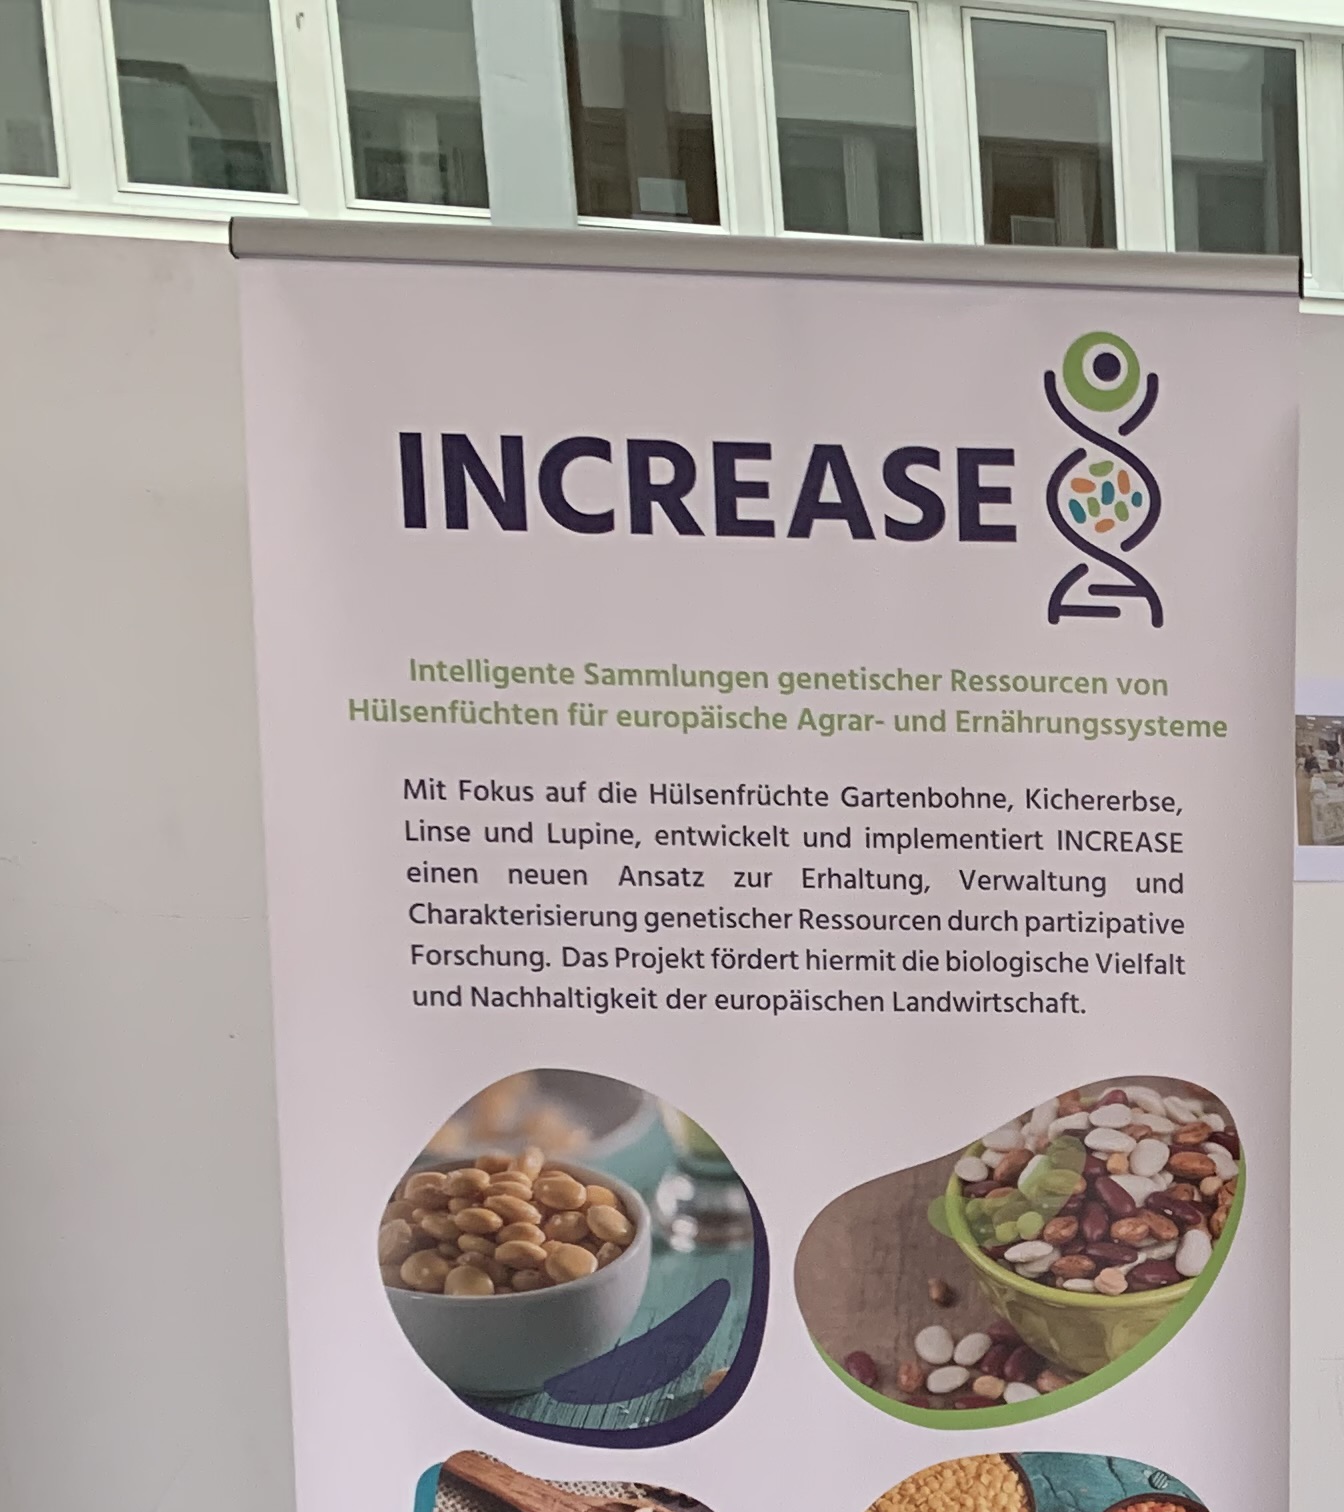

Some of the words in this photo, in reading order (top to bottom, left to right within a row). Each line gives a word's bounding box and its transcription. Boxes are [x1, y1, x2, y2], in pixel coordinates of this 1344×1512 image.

[398, 431, 1017, 542] INCREASE
[410, 658, 575, 689] Intelligente
[583, 662, 768, 694] Sammlungen
[777, 666, 942, 695] genetischer
[950, 668, 1107, 694] Ressourcen
[1116, 677, 1168, 696] von
[348, 698, 558, 726] Hülsenfüchten
[567, 702, 608, 727] für
[616, 704, 787, 734] europäische
[797, 707, 884, 737] Agrar-
[894, 709, 946, 732] und
[955, 709, 1227, 742] Ernährungssysteme
[403, 777, 447, 800] Mit
[458, 779, 534, 802] Fokus
[545, 780, 586, 802] auf
[598, 781, 637, 804] die
[649, 782, 828, 807] Hülsenfrüchte
[840, 786, 1013, 812] Gartenbohne,
[1026, 787, 1182, 816] Kichererbse,
[405, 818, 471, 842] Linse
[484, 821, 533, 843] und
[547, 822, 641, 850] Lupine,
[655, 824, 790, 847] entwickelt
[803, 826, 851, 848] und
[865, 826, 1044, 854] implementiert
[1057, 829, 1183, 853] INCREASE
[407, 860, 478, 883] einen
[508, 868, 587, 885] neuen
[618, 865, 705, 887] Ansatz
[734, 871, 773, 888] zur
[802, 867, 930, 895] Erhaltung,
[959, 869, 1106, 898] Verwaltung
[1136, 872, 1184, 894] und
[409, 901, 637, 933] Charakterisierung
[644, 906, 793, 933] genetischer
[799, 908, 941, 931] Ressourcen
[947, 909, 1018, 931] durch
[1025, 910, 1185, 938] partizipative
[410, 944, 550, 972] Forschung.
[562, 946, 608, 968] Das
[615, 946, 705, 974] Projekt
[710, 947, 799, 970] fördert
[805, 948, 896, 971] hiermit
[902, 949, 939, 971] die
[946, 949, 1088, 977] biologische
[1095, 951, 1185, 975] Vielfalt
[412, 984, 462, 1006] und
[471, 985, 658, 1014] Nachhaltigkeit
[665, 987, 707, 1010] der
[714, 988, 884, 1016] europäischen
[893, 990, 1086, 1014] Landwirtschaft.
